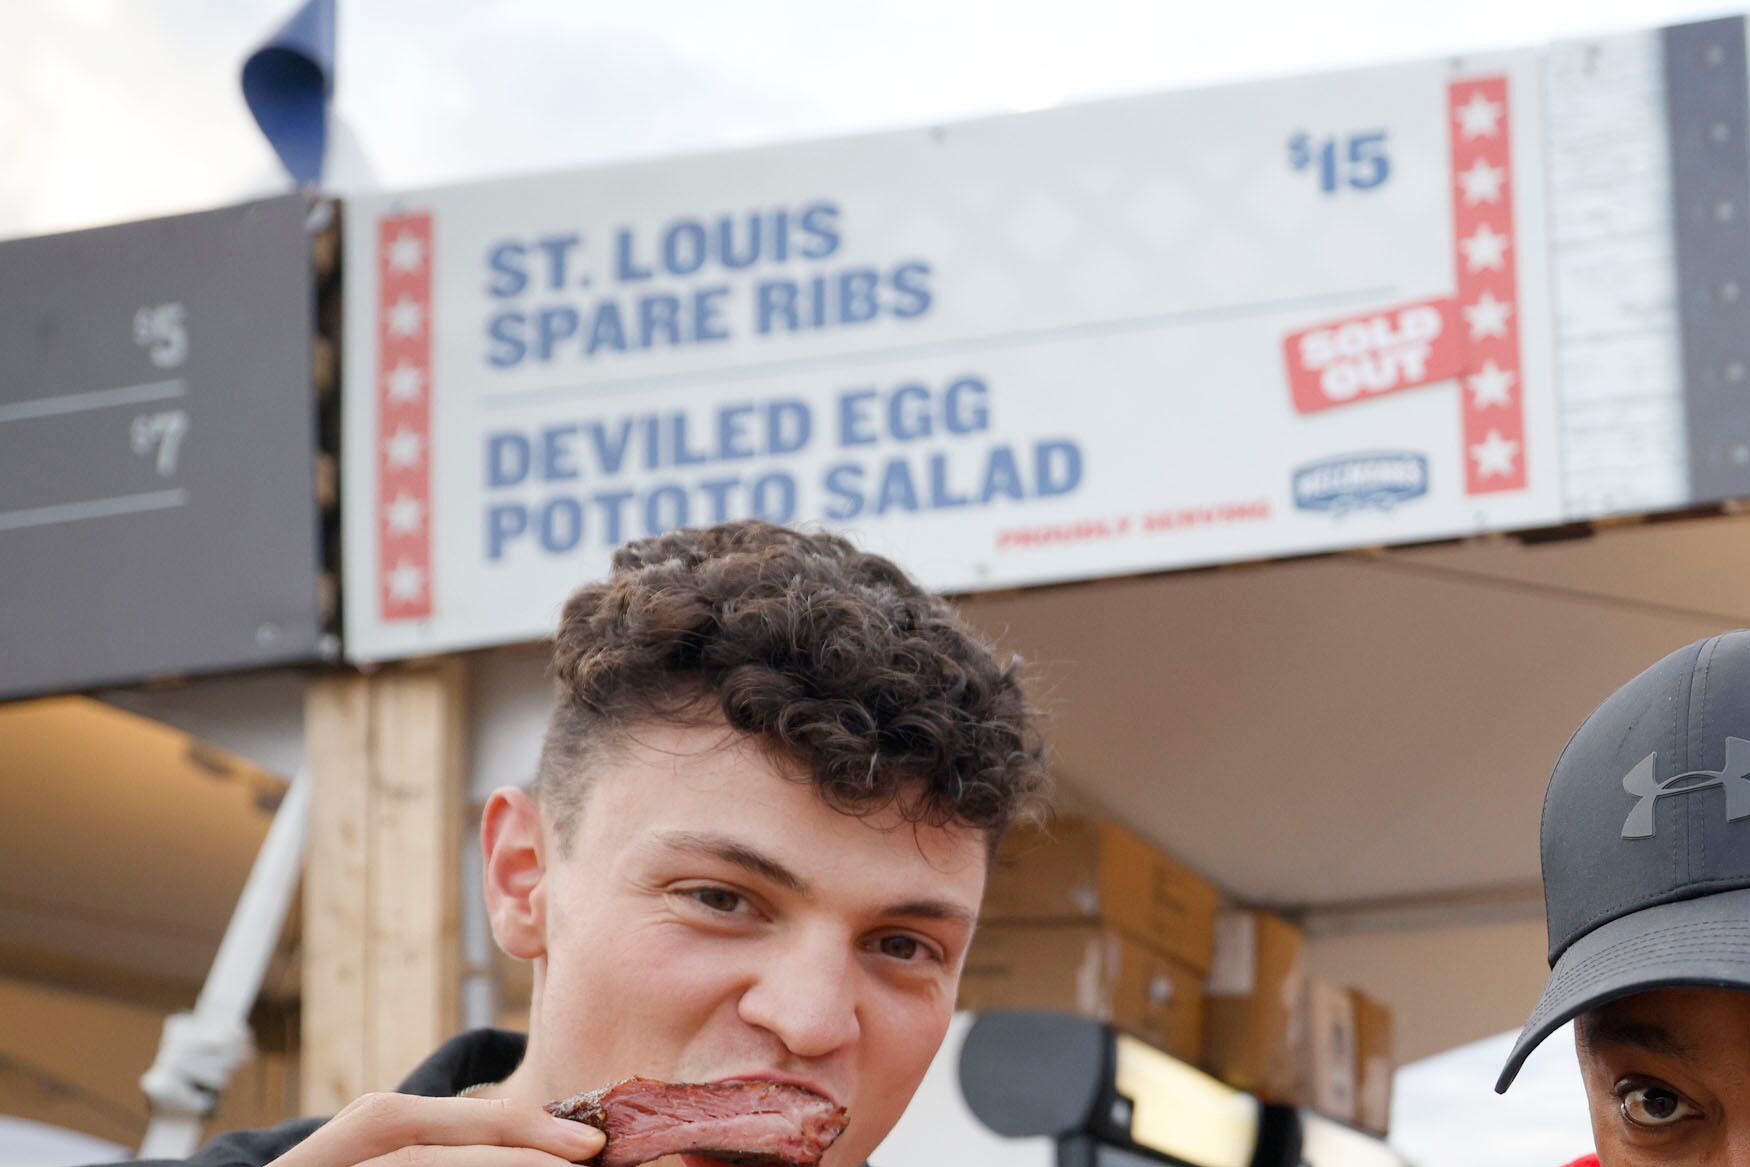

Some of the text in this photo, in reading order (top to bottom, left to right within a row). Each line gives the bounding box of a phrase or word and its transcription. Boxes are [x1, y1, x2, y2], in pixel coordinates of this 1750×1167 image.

[1287, 131, 1391, 195] $15
[487, 202, 841, 298] ST. LOUIS
[487, 261, 934, 369] SPARE RIBS
[1300, 306, 1442, 370] SOLD
[1320, 344, 1432, 400] OUT
[485, 375, 991, 489] DEVILED EGG
[485, 438, 1084, 560] POTOTO SALAD
